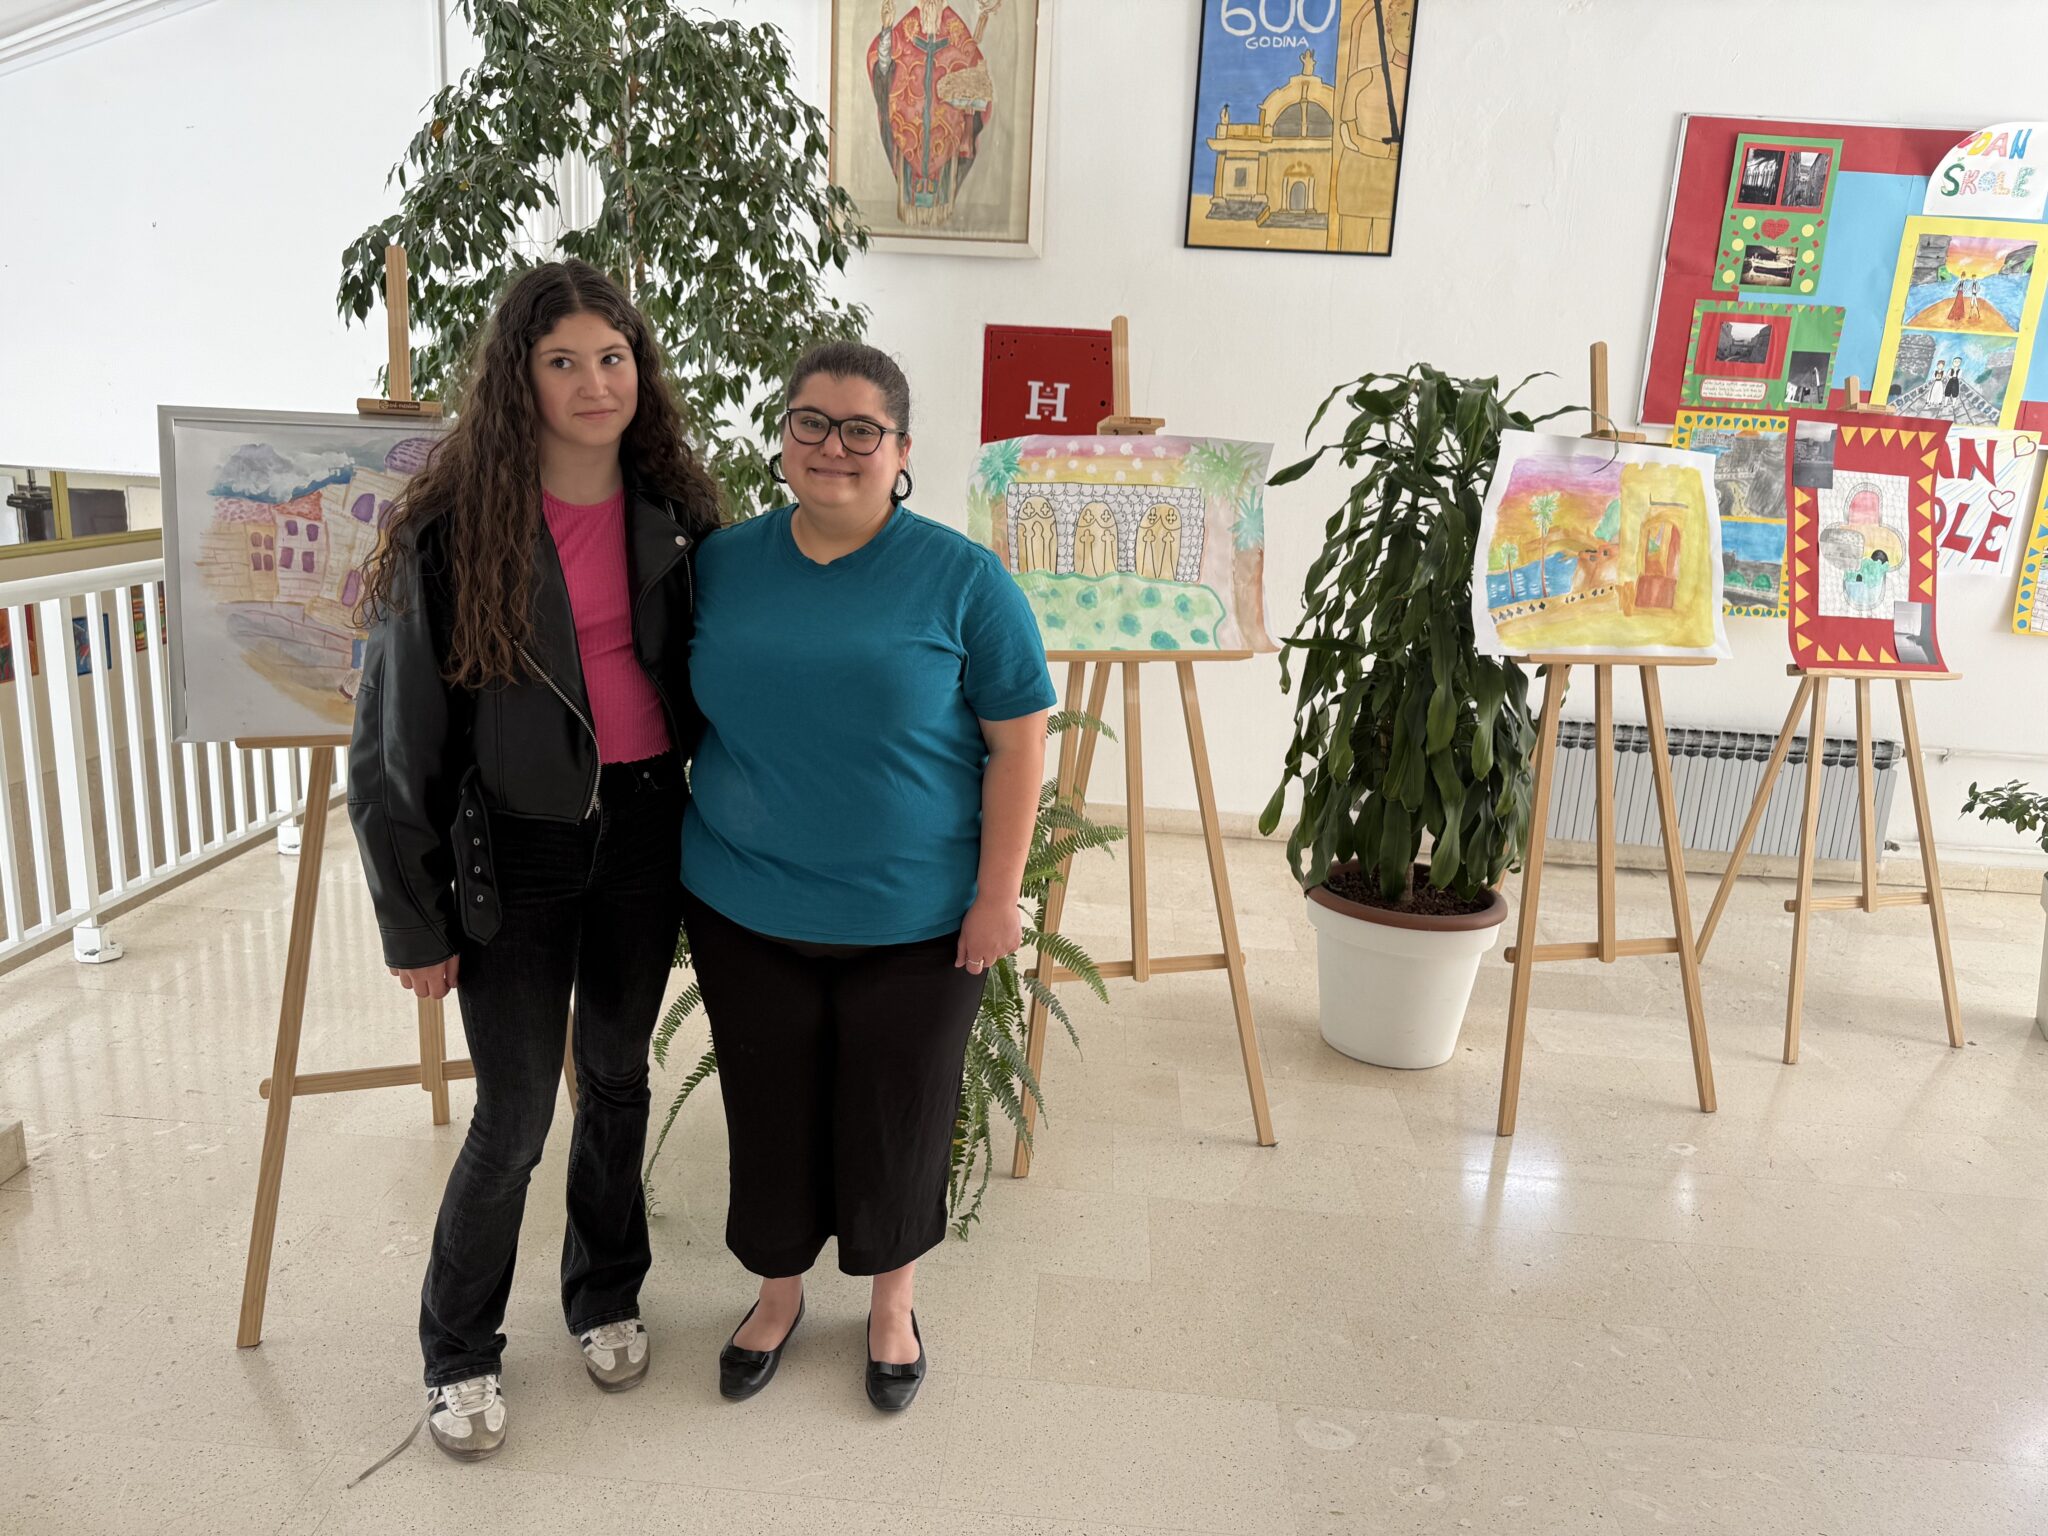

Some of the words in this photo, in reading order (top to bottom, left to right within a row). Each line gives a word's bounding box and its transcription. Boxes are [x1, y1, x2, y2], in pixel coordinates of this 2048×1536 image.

[1220, 0, 1336, 36] 600
[1245, 35, 1310, 50] GODINA
[1966, 128, 2033, 160] DAN
[1940, 157, 2036, 198] ŠKOLE
[1025, 380, 1071, 422] H
